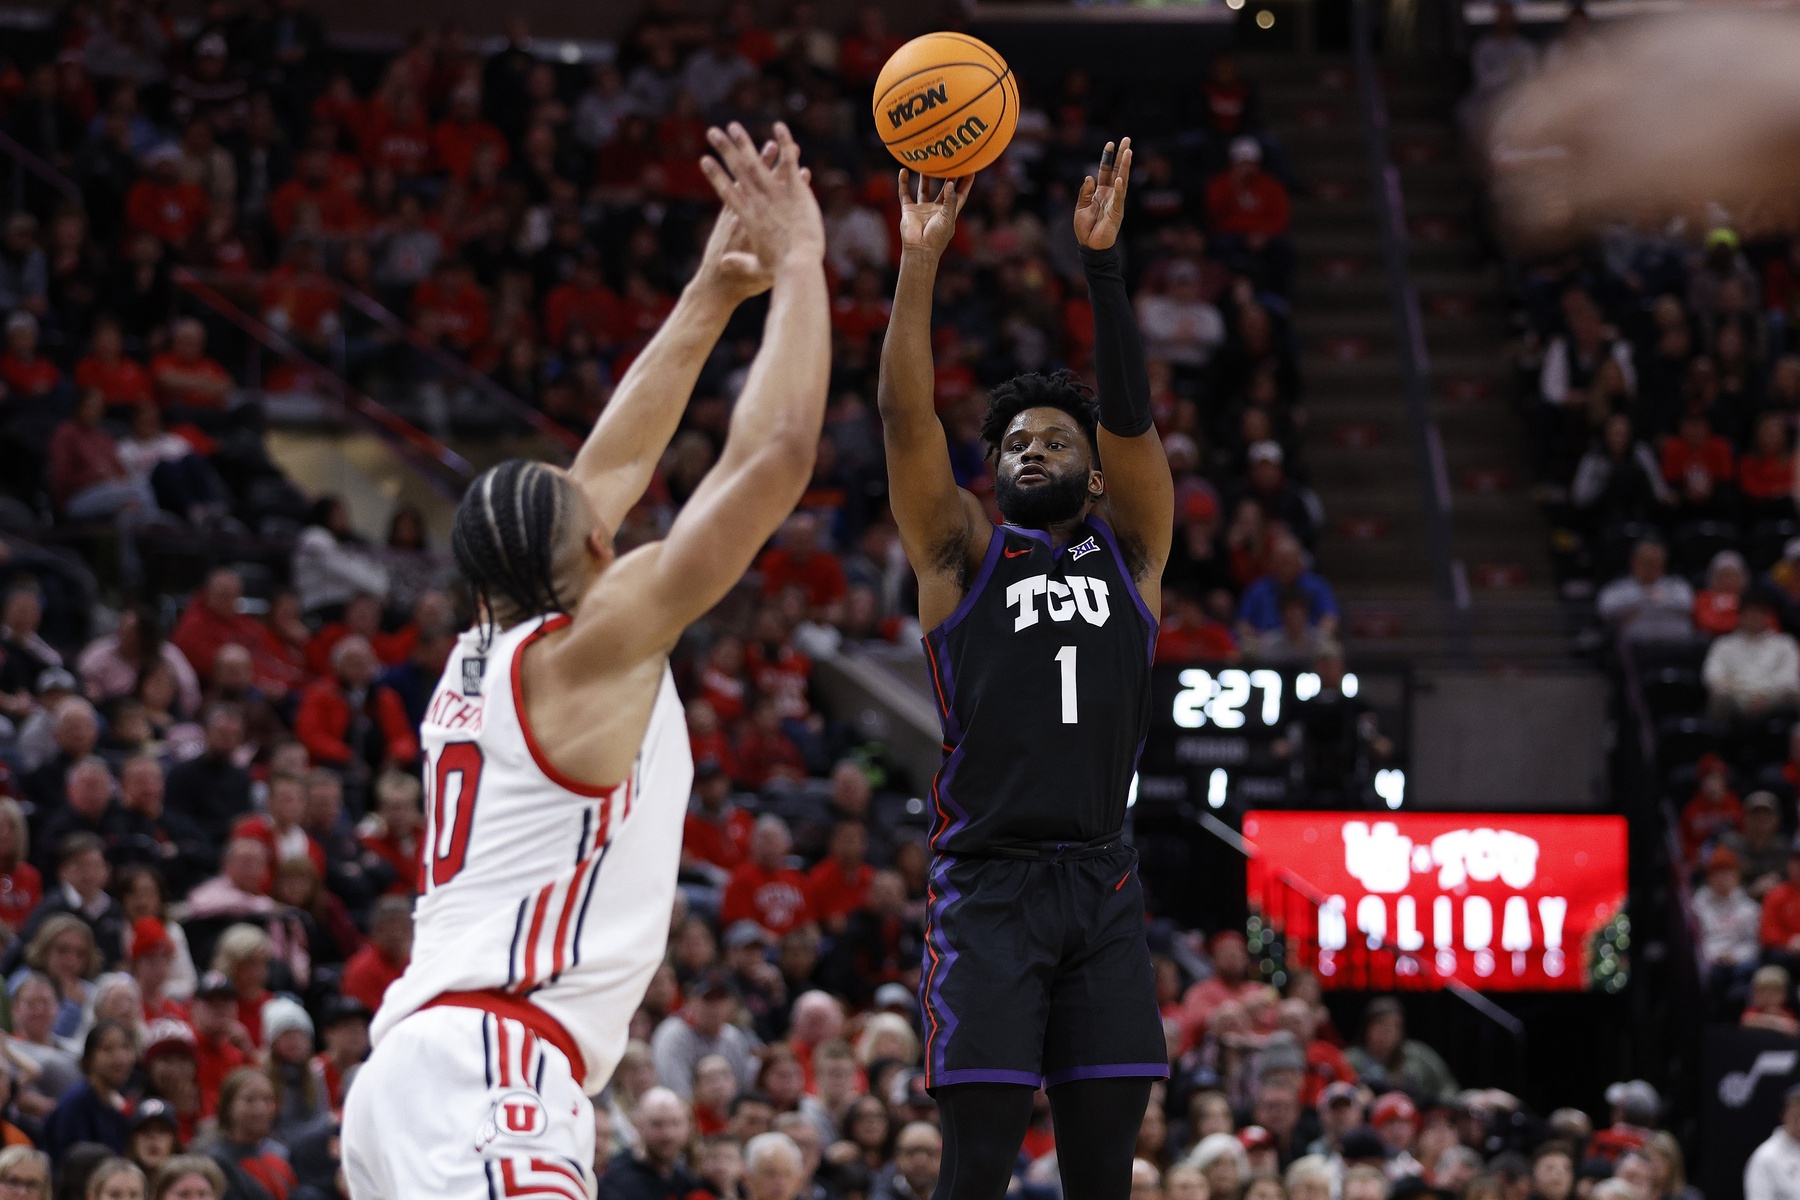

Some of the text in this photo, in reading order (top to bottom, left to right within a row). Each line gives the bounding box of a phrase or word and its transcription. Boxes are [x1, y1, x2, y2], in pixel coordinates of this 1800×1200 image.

[887, 82, 949, 129] NCAA
[899, 114, 989, 162] Wilson
[1006, 574, 1111, 633] TCU
[1054, 646, 1078, 723] 1
[504, 1105, 537, 1131] U
